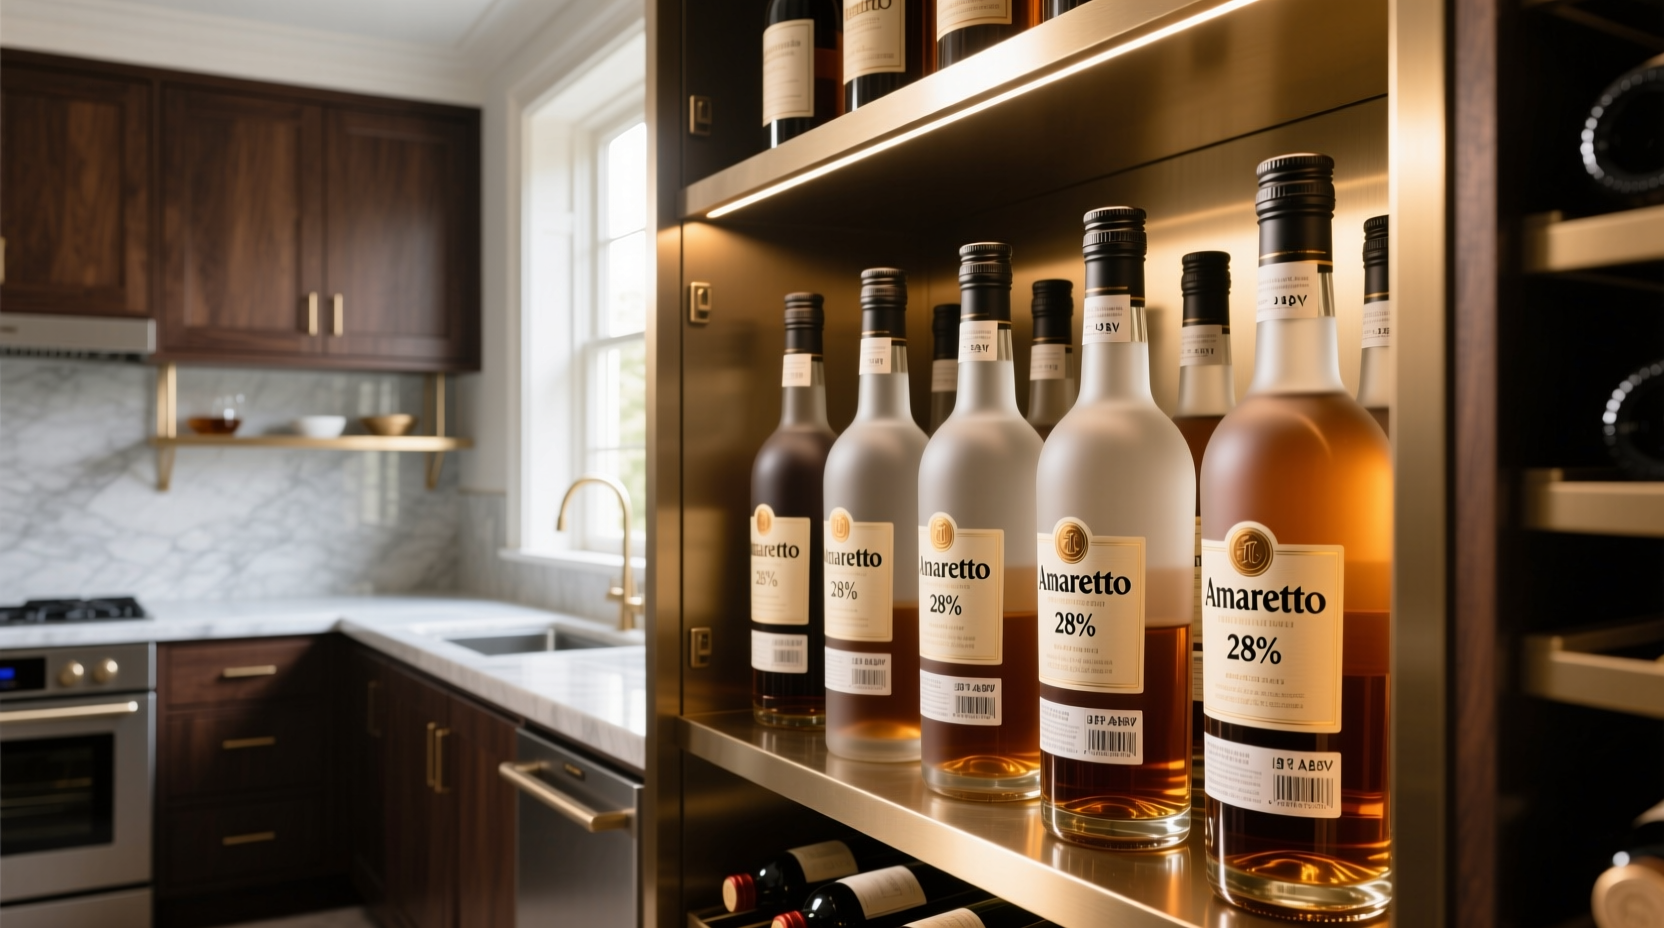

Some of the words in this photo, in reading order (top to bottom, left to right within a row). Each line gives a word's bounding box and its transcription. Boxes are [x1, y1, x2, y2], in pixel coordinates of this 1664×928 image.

[830, 581, 858, 600] 28%
[1039, 565, 1132, 596] Amaretto
[930, 593, 962, 616] 28%
[1206, 577, 1327, 615] Amaretto
[1054, 611, 1096, 638] 28%
[1227, 633, 1282, 665] 28%
